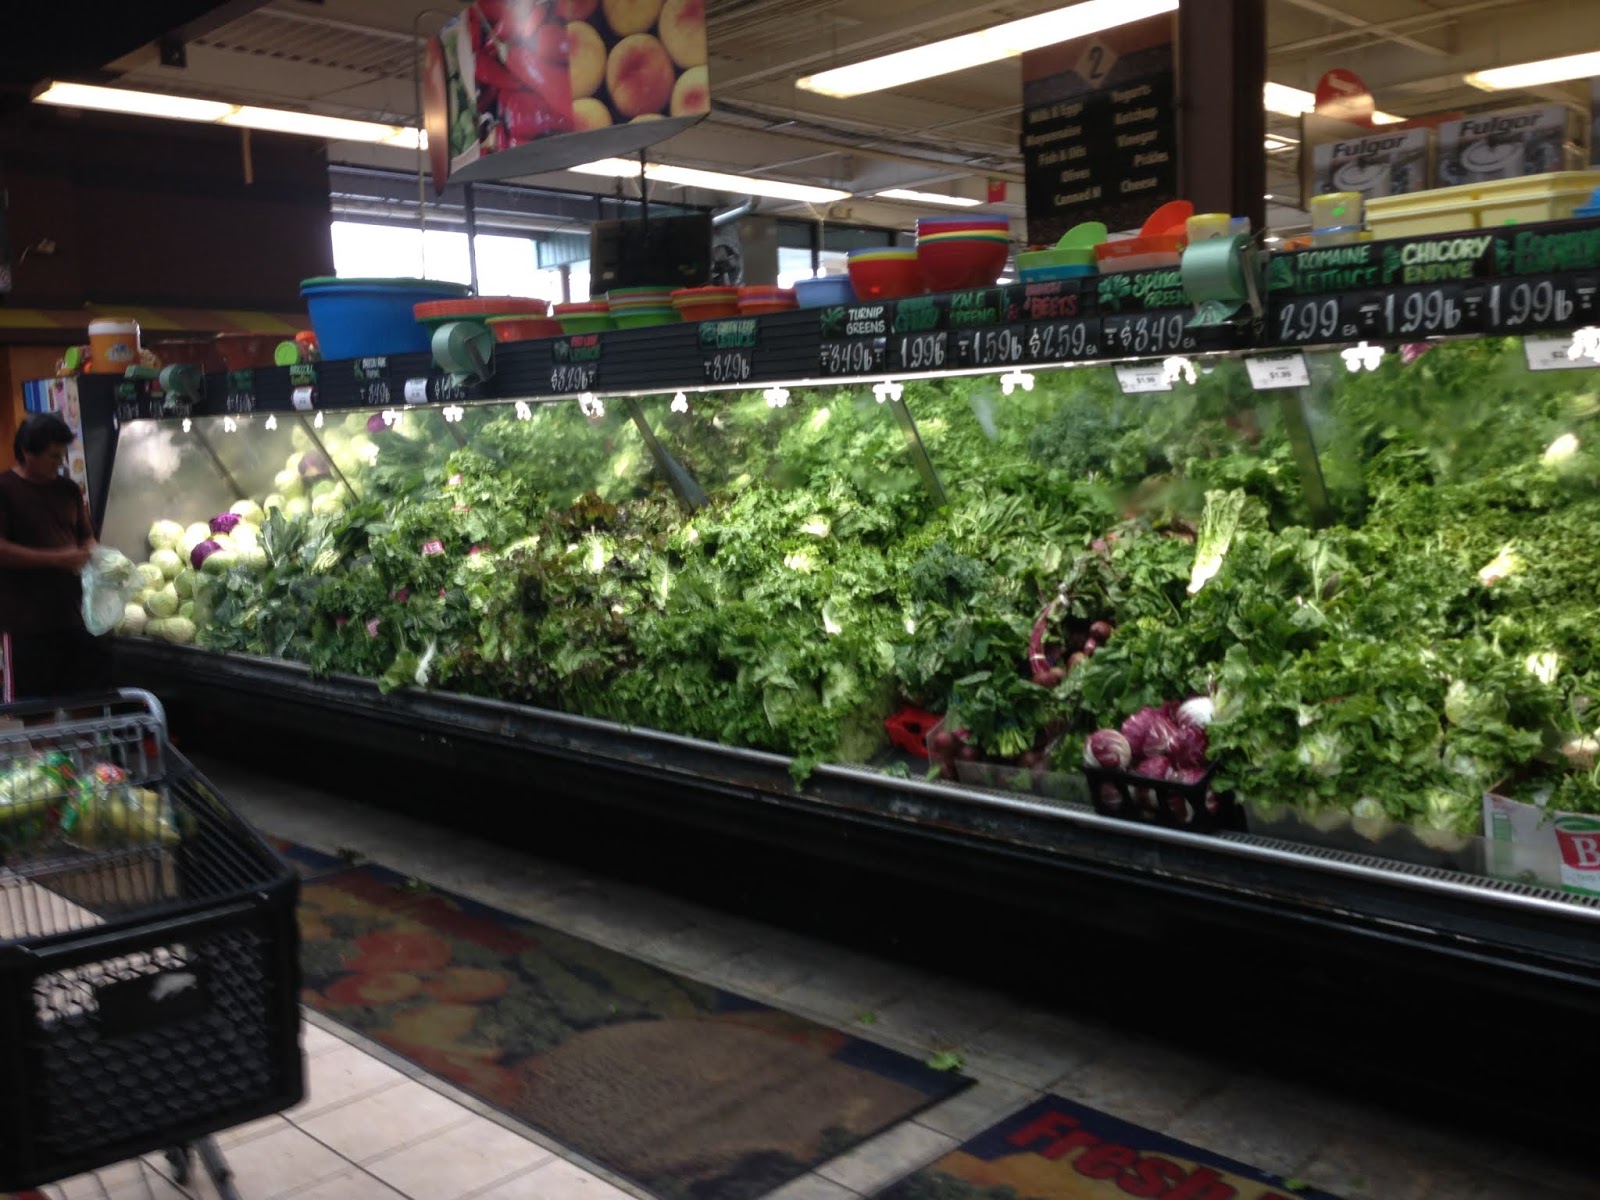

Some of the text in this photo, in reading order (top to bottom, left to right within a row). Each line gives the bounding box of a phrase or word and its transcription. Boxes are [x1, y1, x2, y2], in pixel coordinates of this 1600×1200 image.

[1088, 46, 1104, 79] 2
[1459, 113, 1546, 137] Fulgor
[1297, 245, 1371, 270] ROMAINE
[1402, 235, 1492, 265] CHICORY
[1403, 261, 1474, 284] ENDIVE
[848, 306, 884, 321] TURNIP
[846, 320, 886, 335] GREENS
